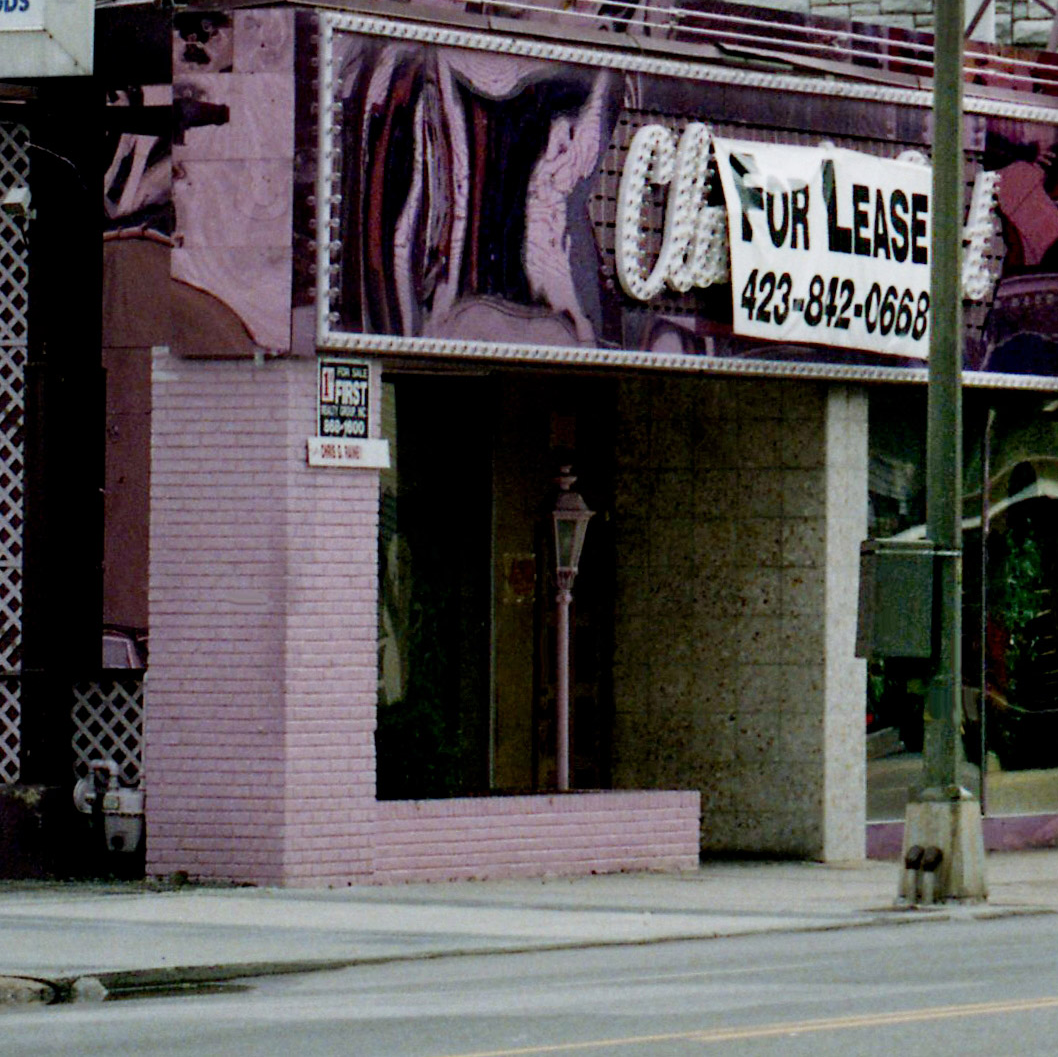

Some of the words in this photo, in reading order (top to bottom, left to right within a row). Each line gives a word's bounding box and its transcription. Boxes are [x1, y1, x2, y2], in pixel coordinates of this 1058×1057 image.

[821, 158, 929, 265] LEASE
[741, 268, 930, 341] 423-842-0668
[335, 379, 368, 406] FIRST
